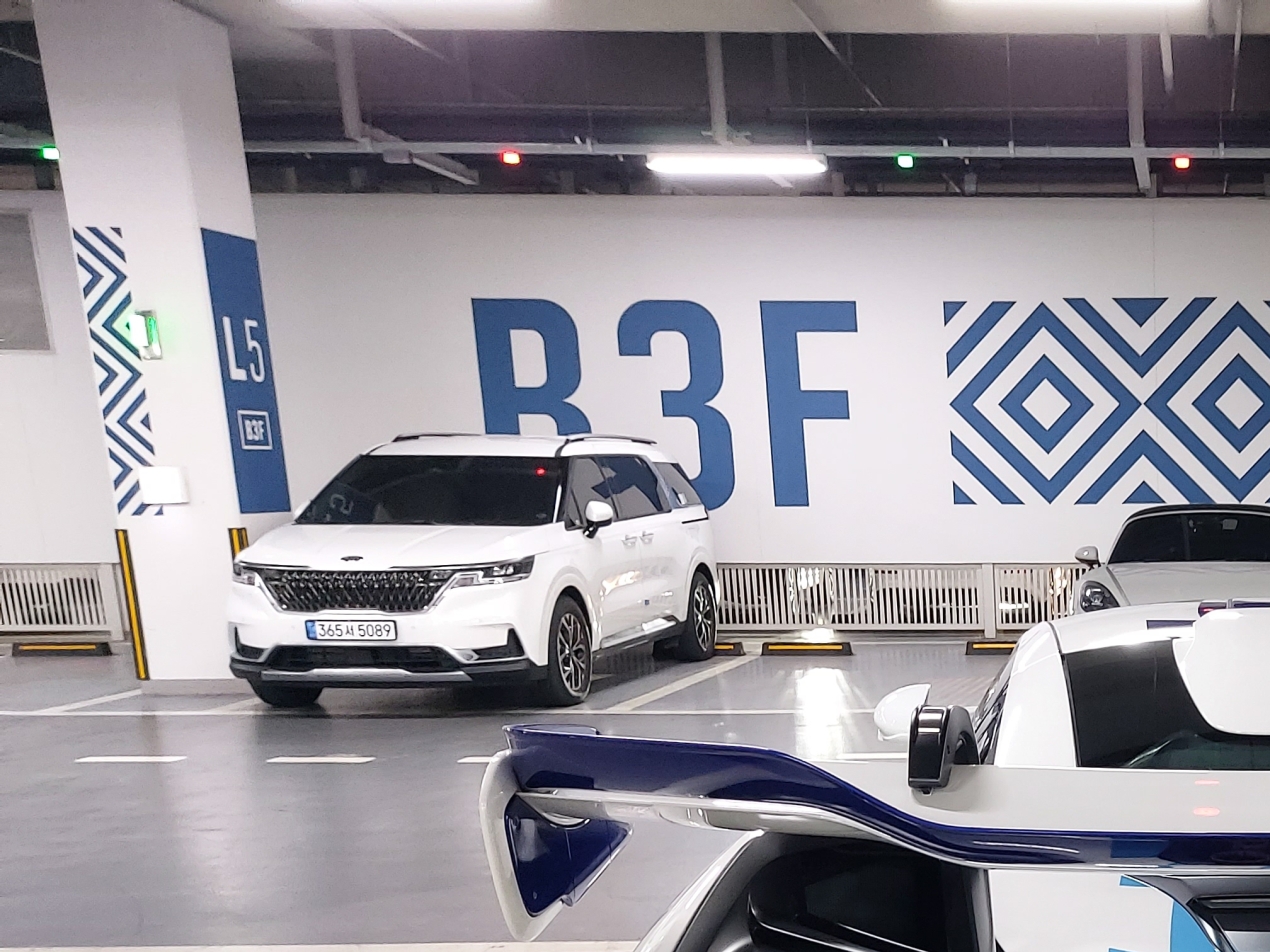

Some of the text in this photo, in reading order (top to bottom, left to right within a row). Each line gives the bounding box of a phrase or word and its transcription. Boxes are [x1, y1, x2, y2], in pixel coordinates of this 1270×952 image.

[222, 316, 266, 383] L5
[244, 419, 265, 441] B3F
[471, 298, 858, 512] B3F
